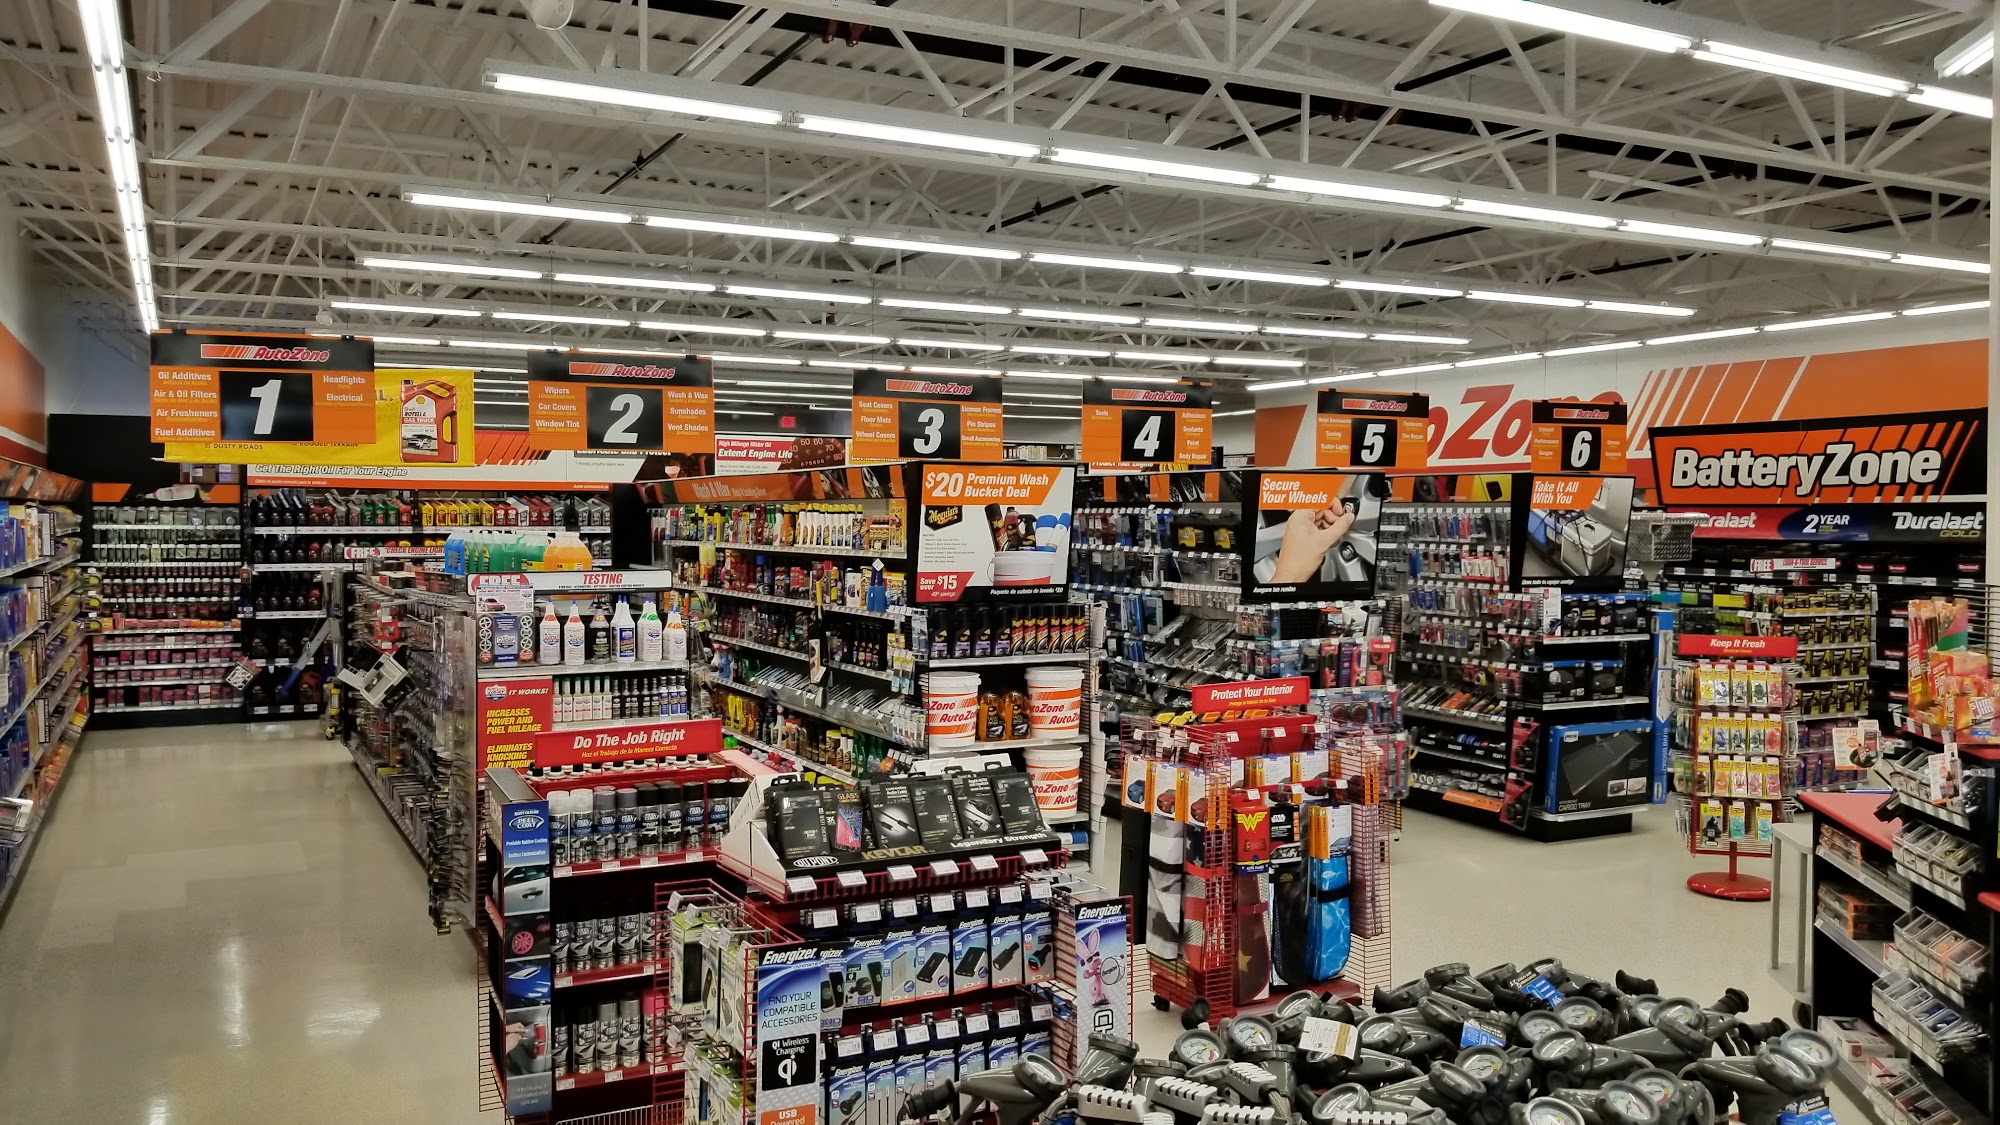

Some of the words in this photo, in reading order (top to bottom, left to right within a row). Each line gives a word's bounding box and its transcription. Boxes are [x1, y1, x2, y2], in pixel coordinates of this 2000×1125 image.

[252, 346, 330, 362] AutoZone
[158, 371, 170, 380] Oil
[172, 372, 212, 381] Additives
[612, 364, 676, 379] AutoZone
[323, 375, 366, 384] Headlights
[544, 386, 570, 396] Wipers
[921, 381, 974, 396] AutoZone
[154, 389, 167, 398] Air
[168, 390, 174, 398] &
[176, 390, 188, 399] Oil
[190, 391, 217, 400] Filters
[326, 393, 364, 402] Electrical
[668, 390, 687, 399] Wash
[694, 392, 709, 400] Wax
[1142, 390, 1187, 402] AutoZone
[250, 379, 282, 434] 1
[552, 404, 577, 412] Covers
[858, 400, 873, 408] Seat
[873, 402, 894, 410] Covers
[1368, 400, 1408, 412] AutoZone
[156, 408, 170, 418] Air
[171, 409, 218, 418] Fresheners
[670, 408, 706, 416] Sunshades
[535, 420, 565, 428] Window
[603, 393, 645, 444] 2
[860, 416, 876, 424] Floor
[876, 416, 892, 424] Mats
[155, 428, 174, 437] Fuel
[176, 428, 216, 438] Additives
[668, 424, 684, 432] Vent
[684, 424, 708, 432] Shades
[914, 408, 945, 455] 3
[856, 430, 875, 438] Wheel
[876, 431, 896, 440] Covers
[1133, 415, 1162, 458] 4
[1361, 423, 1387, 463] 5
[718, 448, 748, 458] Extend
[748, 449, 776, 460] Engine
[778, 450, 794, 459] Life
[1570, 430, 1592, 468] 6
[256, 464, 273, 473] Get
[274, 464, 292, 474] The
[293, 465, 320, 476] Right
[321, 466, 334, 474] Oil
[336, 466, 352, 475] For
[353, 466, 375, 476] Your
[376, 467, 408, 478] Engine
[1671, 442, 1942, 496] BatteryZone
[967, 472, 1018, 486] Premium
[1019, 474, 1048, 486] Wash
[1262, 478, 1300, 490] Secure
[925, 472, 964, 498] $20
[1534, 481, 1555, 492] Take
[1556, 481, 1565, 492] It
[1566, 482, 1580, 492] All
[964, 486, 1004, 498] Bucket
[1006, 486, 1030, 498] Deal
[1262, 490, 1286, 504] Your
[1288, 491, 1328, 504] Wheels
[1532, 492, 1554, 504] With
[1556, 493, 1572, 504] You
[1802, 514, 1819, 534] 2
[1819, 514, 1850, 526] YEAR
[1892, 512, 1984, 530] Duralast
[1939, 530, 1980, 538] GOLD
[354, 547, 376, 559] FREE
[1754, 560, 1772, 572] FREE
[583, 574, 624, 584] TESTING
[920, 577, 936, 586] Save
[937, 575, 958, 590] $15
[1710, 638, 1733, 650] Keep
[1734, 639, 1740, 648] It
[1742, 639, 1766, 648] Fresh
[516, 688, 548, 696] WORKS!
[1210, 690, 1242, 700] Protect
[1244, 686, 1262, 698] Your
[1264, 684, 1294, 696] Interior
[486, 708, 530, 718] INCREASES
[1032, 704, 1065, 713] toZone
[486, 718, 516, 726] POWER
[517, 716, 533, 724] AND
[486, 726, 506, 734] FUEL
[508, 724, 542, 734] MILEAGE
[573, 736, 592, 750] Do
[596, 733, 620, 747] The
[622, 732, 648, 746] Job
[650, 728, 686, 743] Right
[486, 743, 533, 753] ELIMINATES
[592, 750, 599, 758] el
[600, 748, 619, 758] Trabajo
[620, 748, 626, 756] de
[634, 746, 654, 754] Manera
[654, 744, 678, 752] Correcta
[486, 752, 528, 761] KNOCKING
[1034, 784, 1069, 794] toZone
[837, 792, 860, 800] GLASS
[1558, 802, 1578, 811] CARGO
[1578, 802, 1592, 810] TRAY
[950, 836, 1004, 848] Legendary
[1004, 832, 1048, 843] Strength
[861, 845, 928, 861] KEVLAR
[1025, 911, 1050, 920] Energizer
[1078, 904, 1122, 920] Energizer
[959, 918, 984, 930] Energizer
[993, 914, 1020, 924] Energizer
[887, 930, 914, 940] Energizer
[920, 925, 948, 934] Energizer
[854, 938, 882, 948] Energizer
[762, 948, 817, 965] Energizer
[768, 996, 788, 1005] FIND
[790, 991, 812, 1000] YOUR
[764, 1002, 816, 1018] COMPATIBLE
[762, 1013, 818, 1029] ACCESSORIES
[991, 1036, 1017, 1046] Energizer
[1025, 1031, 1050, 1041] Energizer
[782, 1037, 810, 1048] Wireless
[962, 1041, 984, 1051] Energizer
[776, 1046, 806, 1056] Charging
[929, 1048, 954, 1057] Energizer
[899, 1053, 924, 1062] Energizer
[869, 1058, 894, 1069] Energizer
[835, 1065, 864, 1077] Energizer
[779, 1110, 797, 1120] USB
